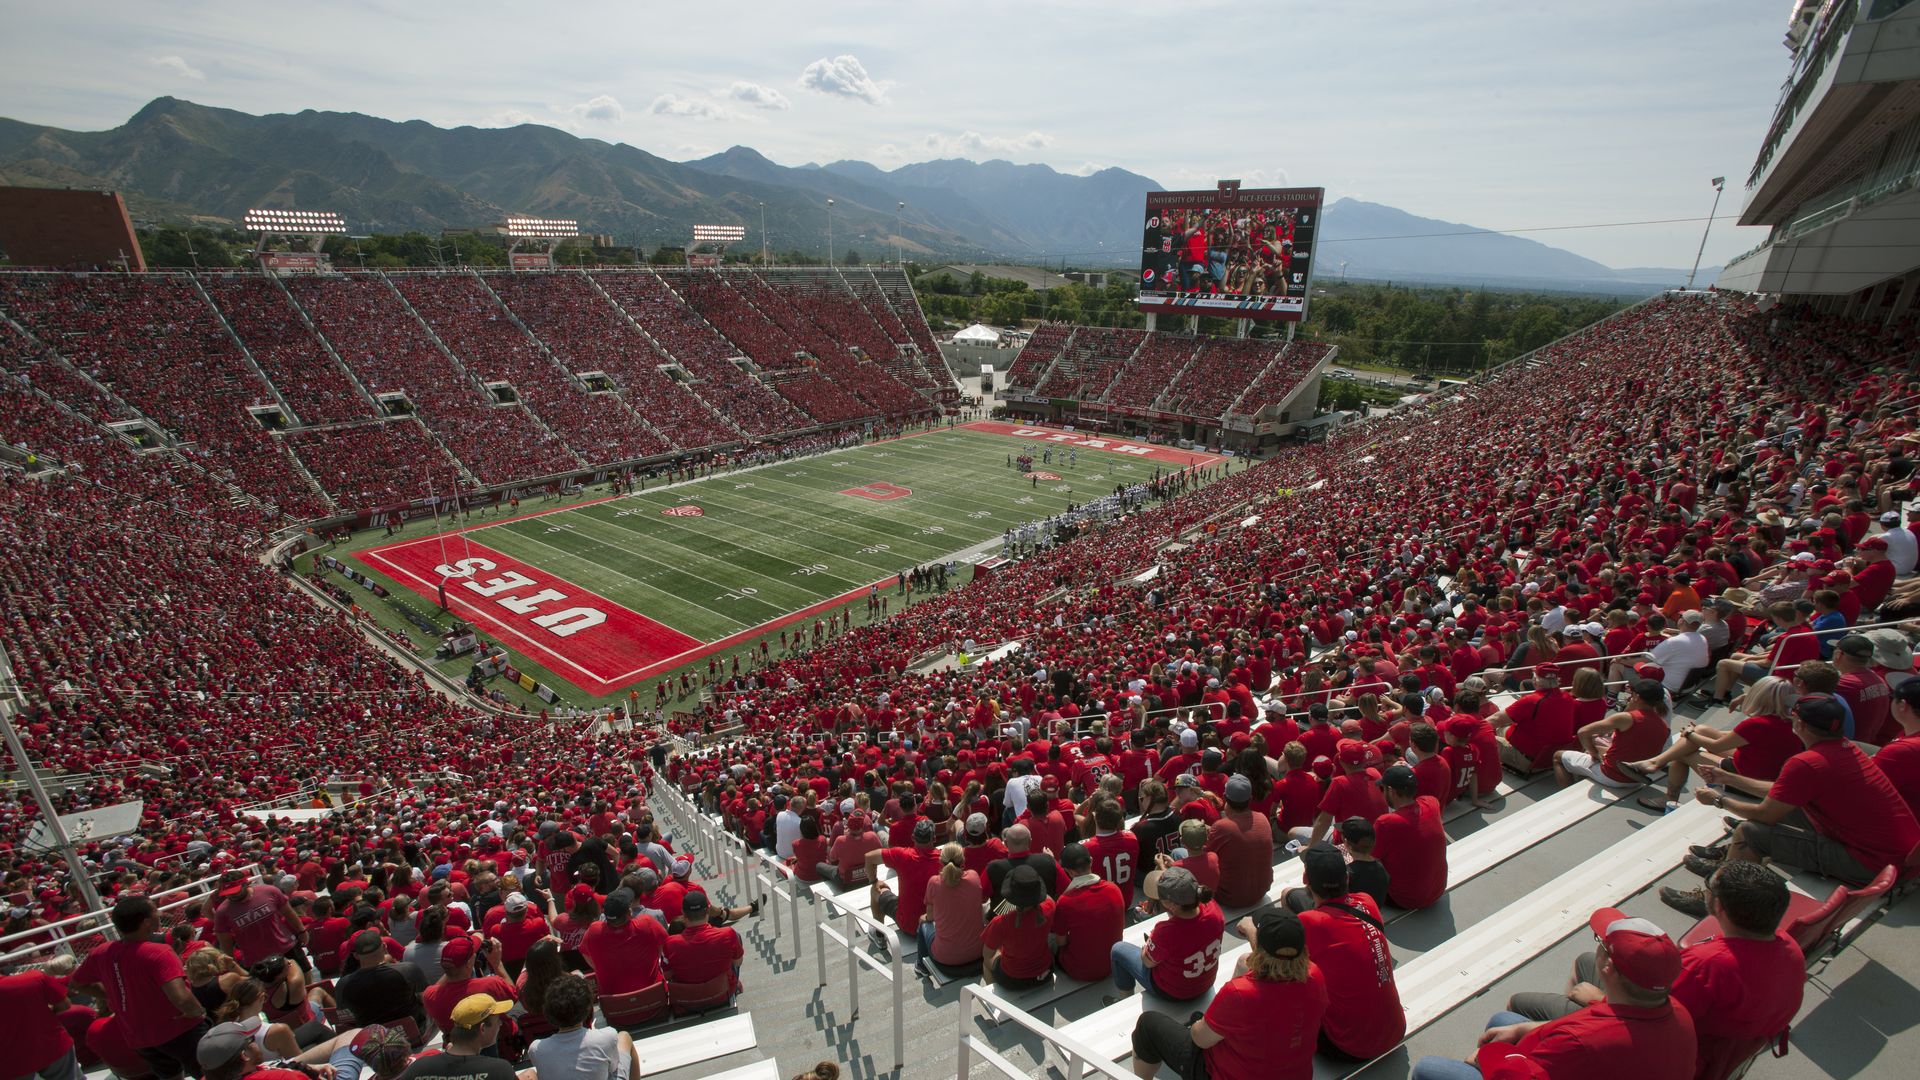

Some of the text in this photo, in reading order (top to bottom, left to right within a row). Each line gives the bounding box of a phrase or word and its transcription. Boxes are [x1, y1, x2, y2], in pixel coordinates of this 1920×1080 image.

[1149, 195, 1184, 205] UNIVERSITY
[1198, 195, 1215, 203] UTAH
[1217, 180, 1241, 203] U
[1240, 193, 1315, 203] RICE-ECCLES STADIUM
[1011, 429, 1156, 455] UTAH
[838, 481, 915, 500] U
[410, 507, 433, 516] HEALTH
[862, 543, 890, 554] 30
[798, 564, 829, 576] 20
[432, 557, 609, 638] UTES
[723, 587, 758, 601] 10
[1155, 831, 1180, 856] 15
[1103, 852, 1131, 885] 16
[234, 905, 272, 928] UTAH
[1183, 938, 1221, 979] 33
